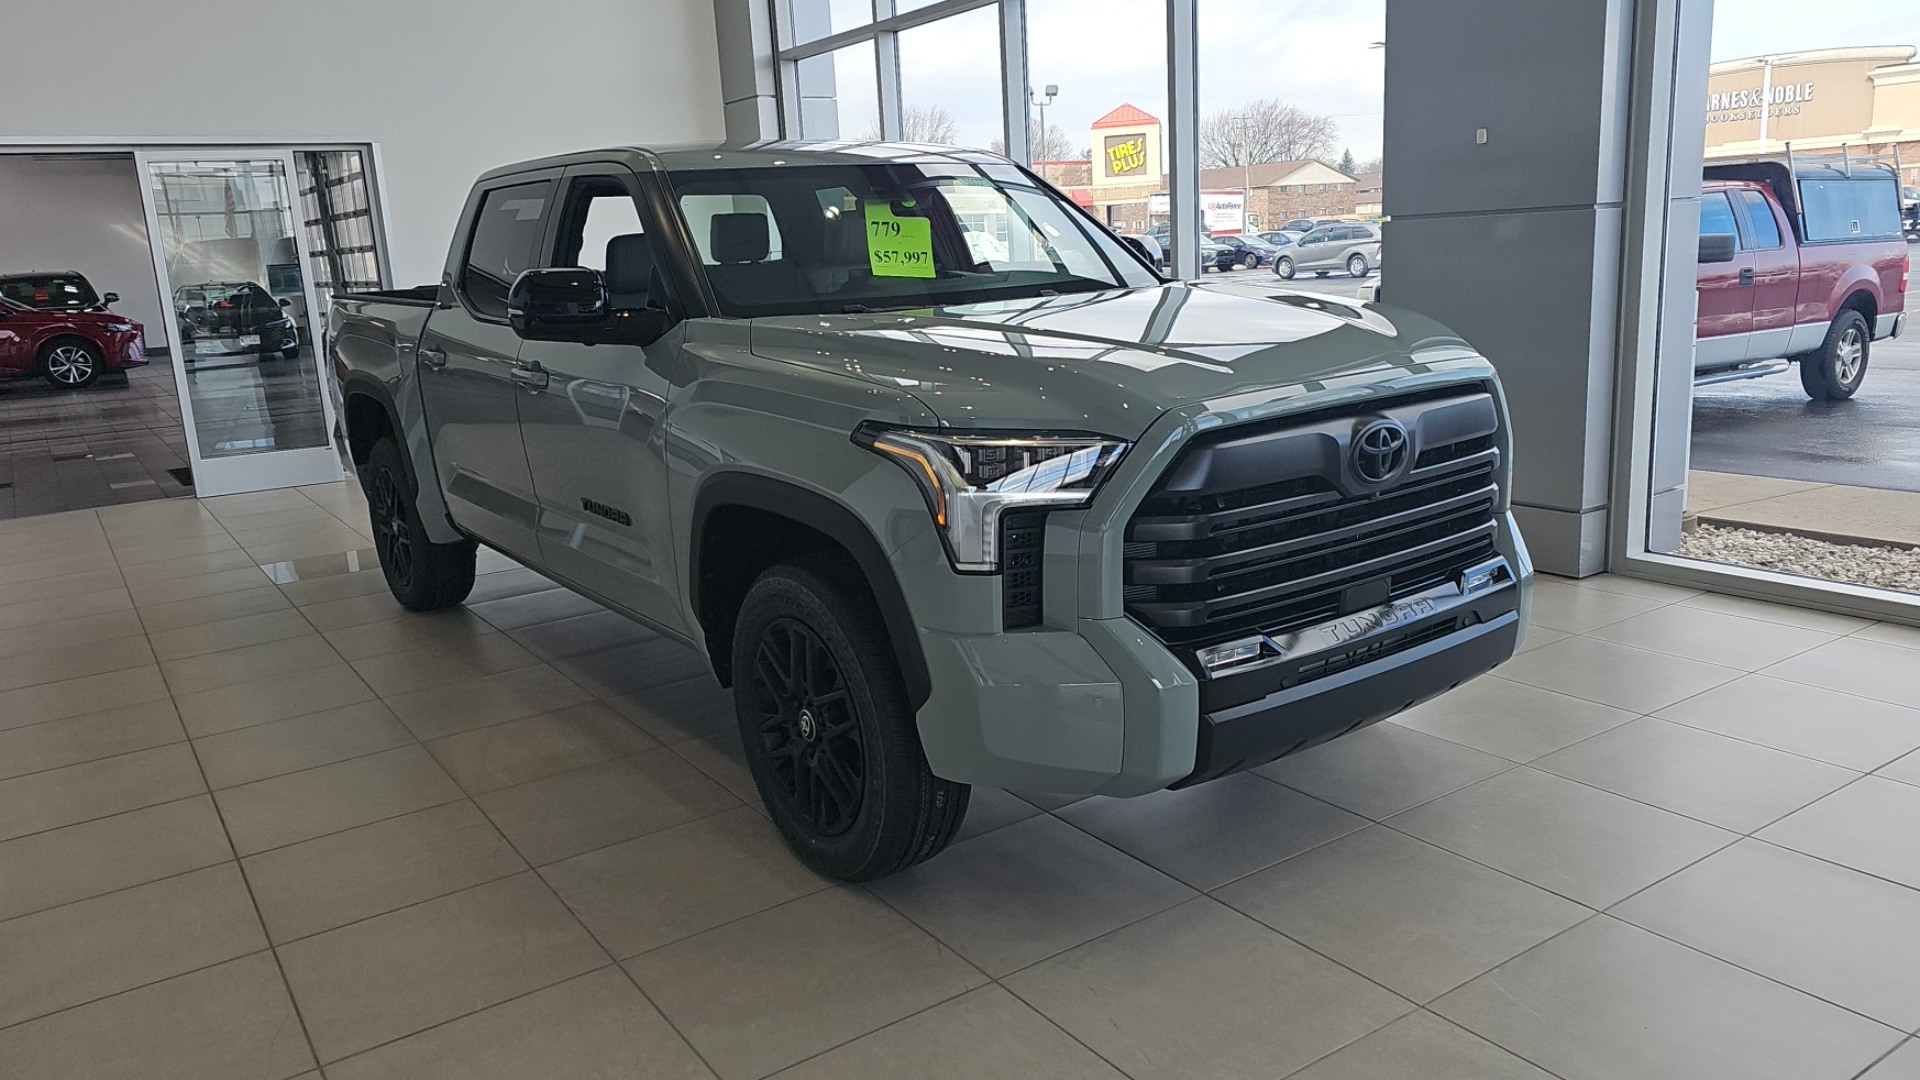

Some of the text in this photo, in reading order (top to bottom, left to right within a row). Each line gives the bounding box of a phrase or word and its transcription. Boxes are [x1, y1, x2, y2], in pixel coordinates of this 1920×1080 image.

[1106, 137, 1144, 161] TIRES
[1112, 152, 1146, 175] PLUS
[871, 221, 901, 238] 779
[874, 250, 928, 267] $57,997
[580, 497, 633, 527] TUNDRA
[1320, 597, 1434, 641] TUNDRA
